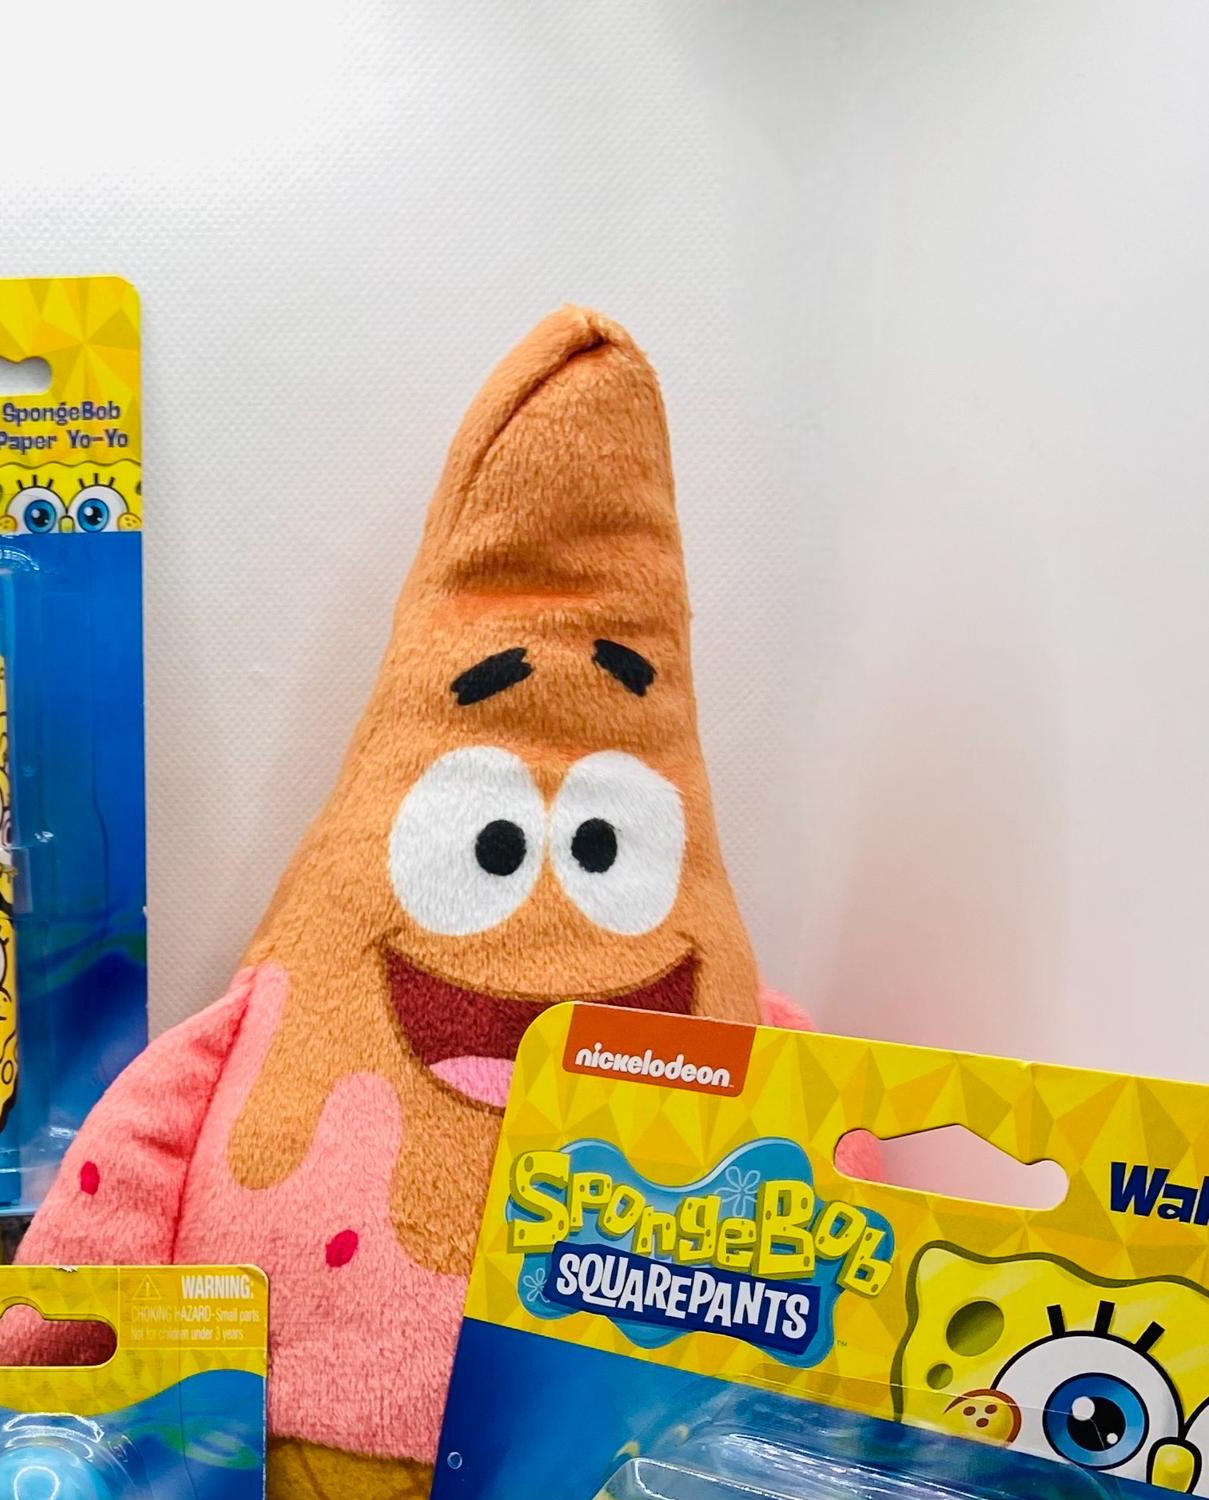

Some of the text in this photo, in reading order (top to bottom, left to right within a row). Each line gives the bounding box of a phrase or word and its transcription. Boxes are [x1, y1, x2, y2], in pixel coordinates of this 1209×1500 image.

[1, 401, 121, 427] SpongeBob
[67, 428, 129, 449] Yo-Yo
[574, 1043, 732, 1088] nickelodeon
[508, 1150, 894, 1298] SpongeBob
[181, 1275, 254, 1299] WARNING:
[556, 1252, 810, 1340] SQUAREPANTS
